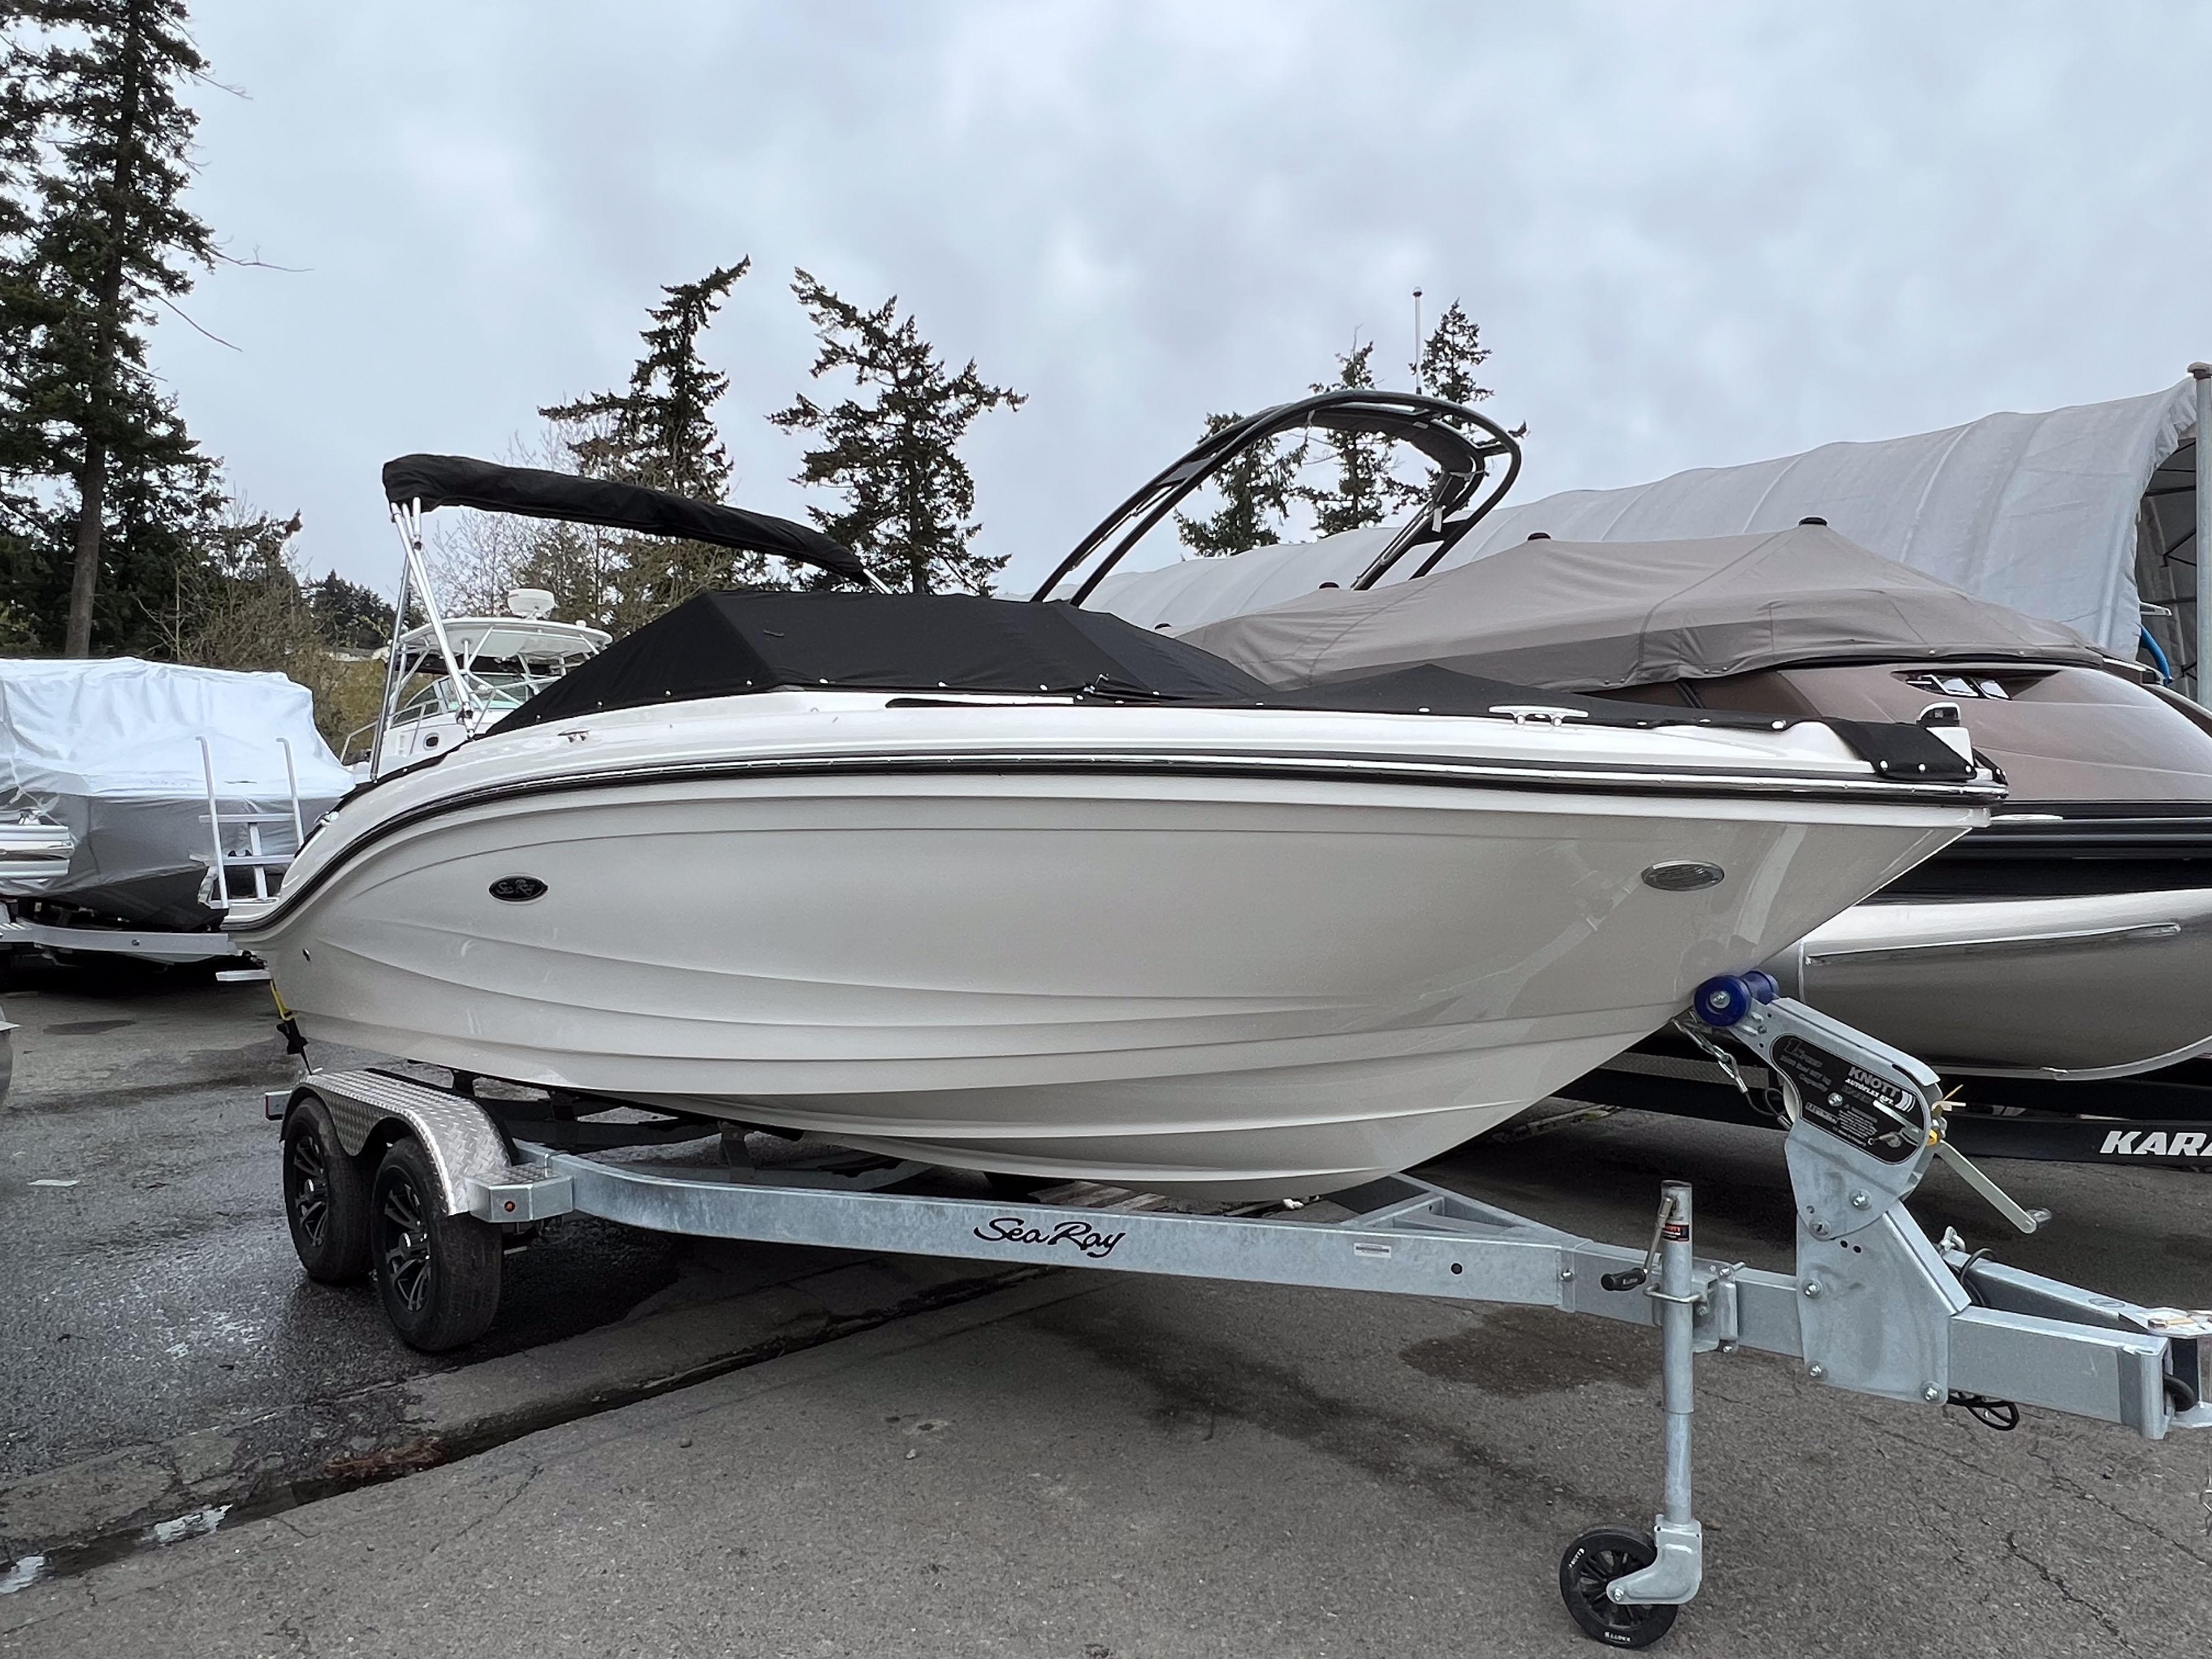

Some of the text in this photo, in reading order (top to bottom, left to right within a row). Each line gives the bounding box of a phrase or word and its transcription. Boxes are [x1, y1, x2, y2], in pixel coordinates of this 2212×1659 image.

[1848, 1066, 1900, 1097] KNOTT
[973, 1217, 1126, 1258] Sea Ray
